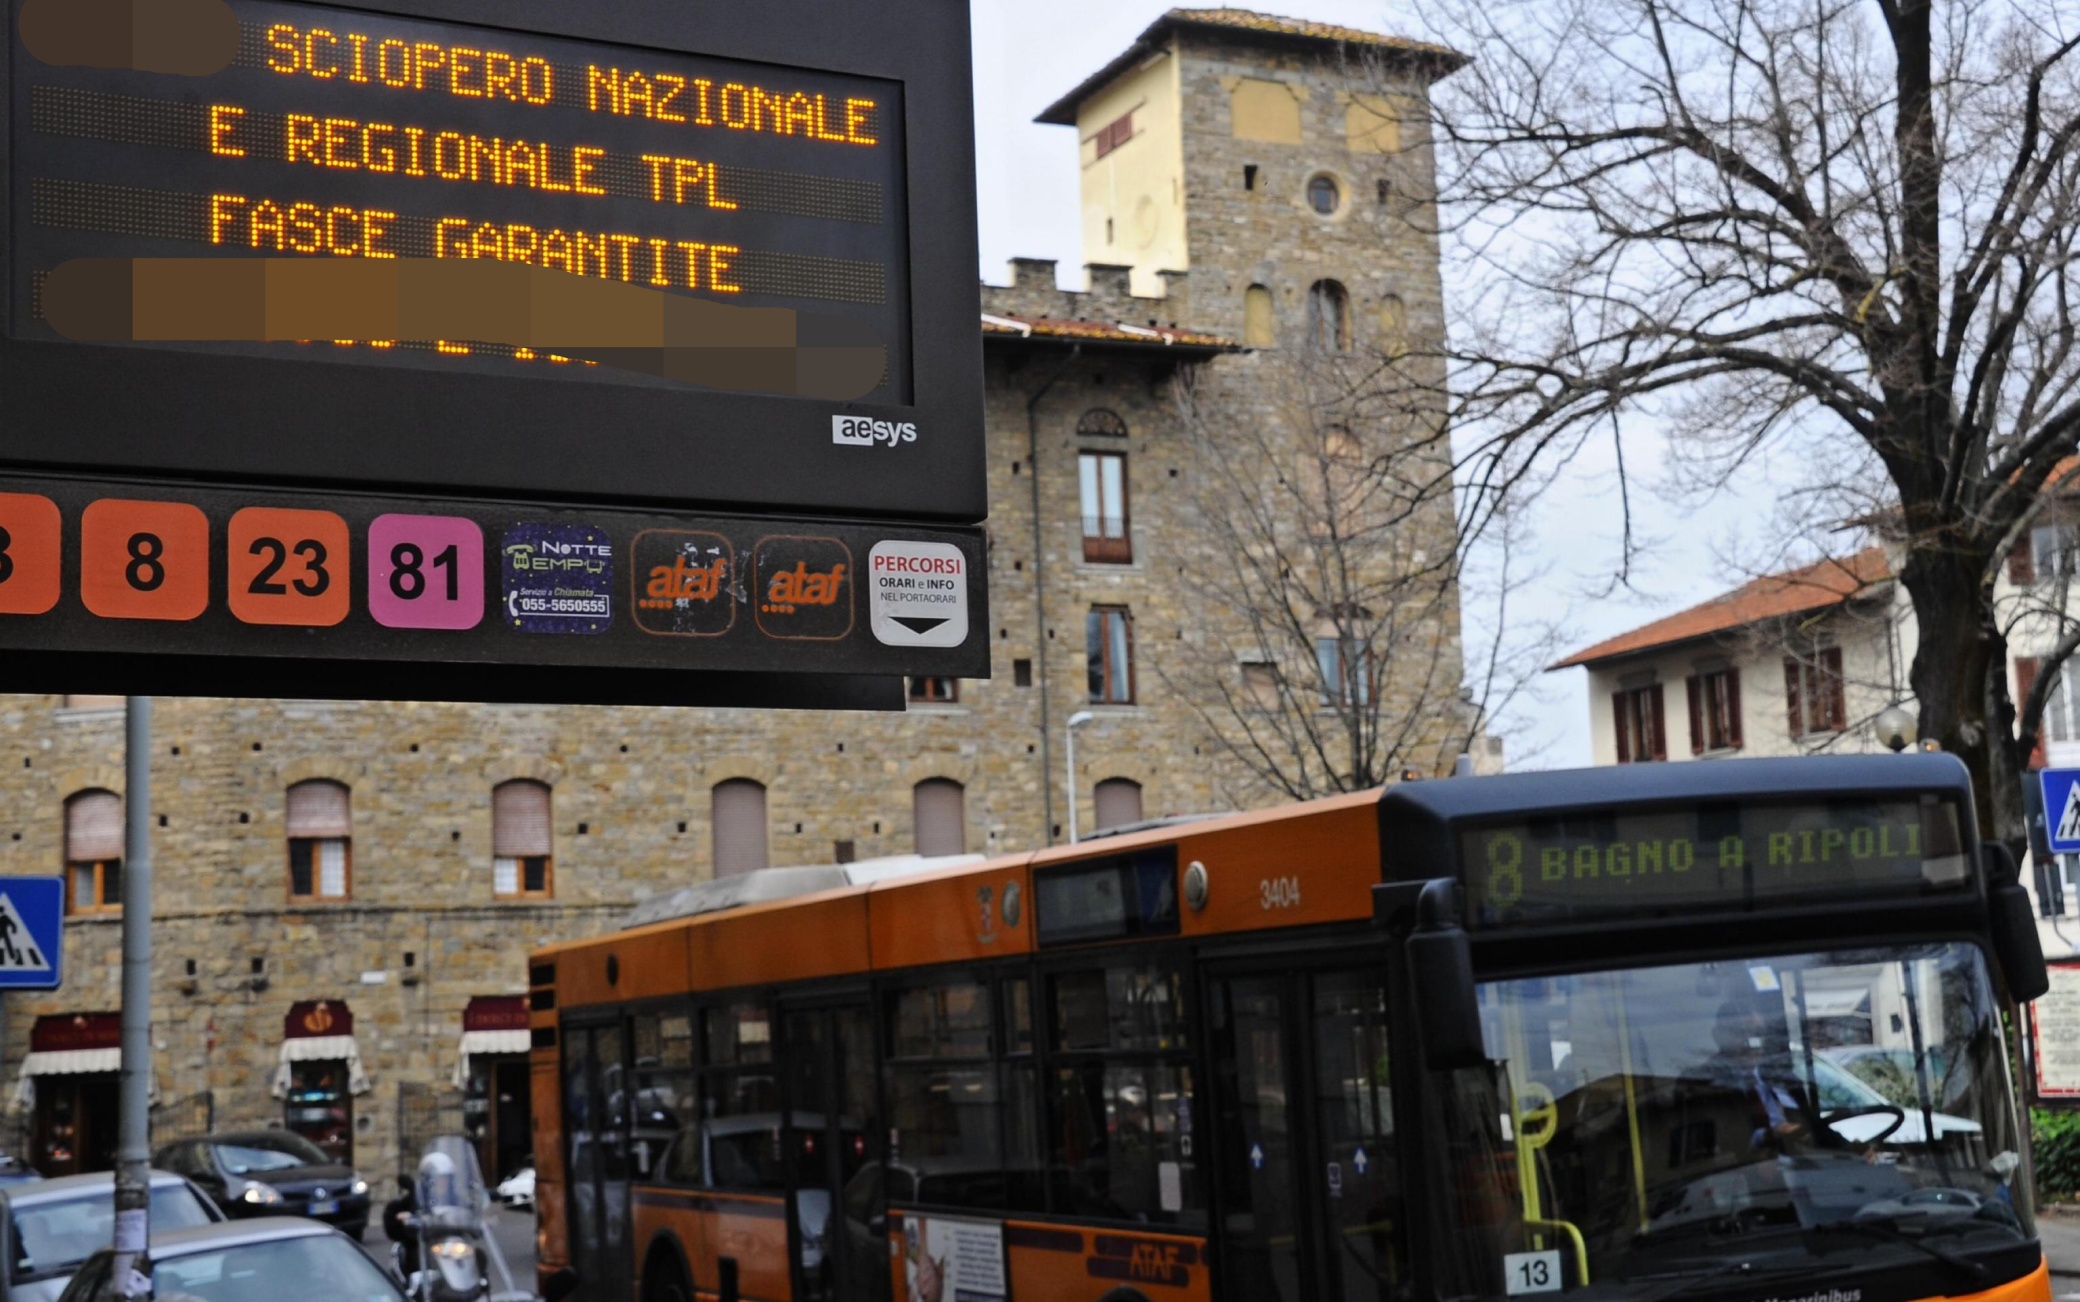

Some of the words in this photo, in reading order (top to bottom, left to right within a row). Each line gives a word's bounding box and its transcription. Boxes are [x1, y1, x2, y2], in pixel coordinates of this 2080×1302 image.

[268, 24, 552, 104] SCIOPERO
[589, 64, 877, 145] NAZIONALE
[211, 105, 245, 157] E
[287, 113, 606, 194] REGIONALE
[641, 155, 738, 210] TPL
[211, 194, 396, 258] FASCE
[436, 218, 740, 292] GARANTITE
[841, 418, 917, 448] aesys
[125, 532, 165, 592] 8
[248, 536, 330, 597] 23
[388, 542, 459, 601] 81
[647, 554, 727, 601] ataf
[874, 555, 960, 574] PERCORSI
[520, 587, 547, 596] Servizio
[554, 587, 594, 597] Chiamata
[769, 561, 846, 605] ataf
[879, 577, 915, 588] ORARI
[918, 580, 924, 589] e
[927, 579, 954, 590] INFO
[880, 592, 898, 602] NEL
[900, 592, 957, 604] PORTAORARI
[522, 598, 606, 612] 055-5650555
[1487, 832, 1523, 908] 8
[1540, 838, 1694, 881] BAGNO
[1719, 834, 1745, 868] A
[1768, 823, 1921, 865] RIPOLI
[1259, 875, 1301, 911] 3404
[1129, 1243, 1179, 1281] ATAF
[1520, 1260, 1549, 1287] 13
